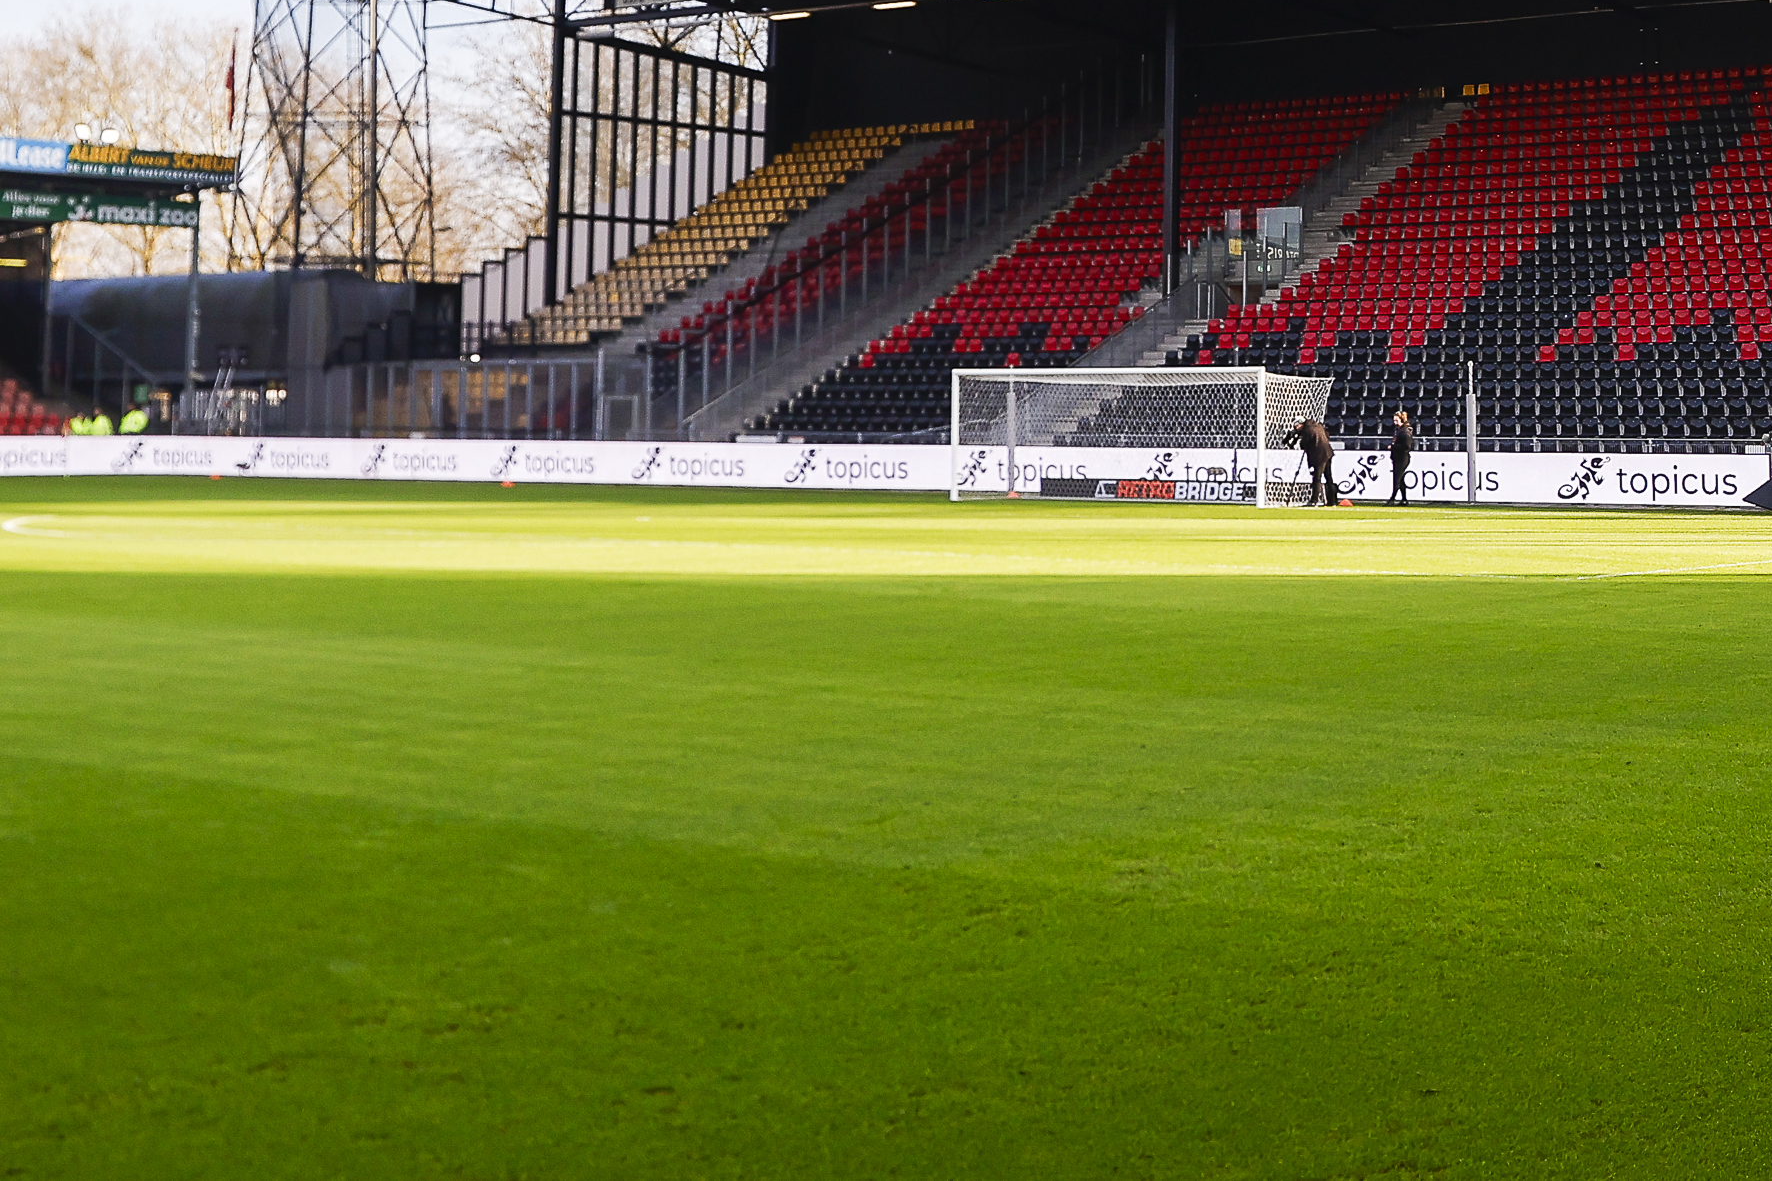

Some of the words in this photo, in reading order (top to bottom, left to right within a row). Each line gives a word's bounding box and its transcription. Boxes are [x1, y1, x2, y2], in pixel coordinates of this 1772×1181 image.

[97, 201, 156, 222] maxi
[158, 208, 198, 226] zoo
[0, 446, 66, 471] picus
[270, 443, 329, 472] topicus
[392, 444, 457, 472] topicus
[524, 448, 595, 475] topicus
[669, 451, 744, 479] topicus
[825, 454, 908, 484] topicus
[1390, 463, 1499, 497] opicus
[1618, 464, 1738, 501] topicus
